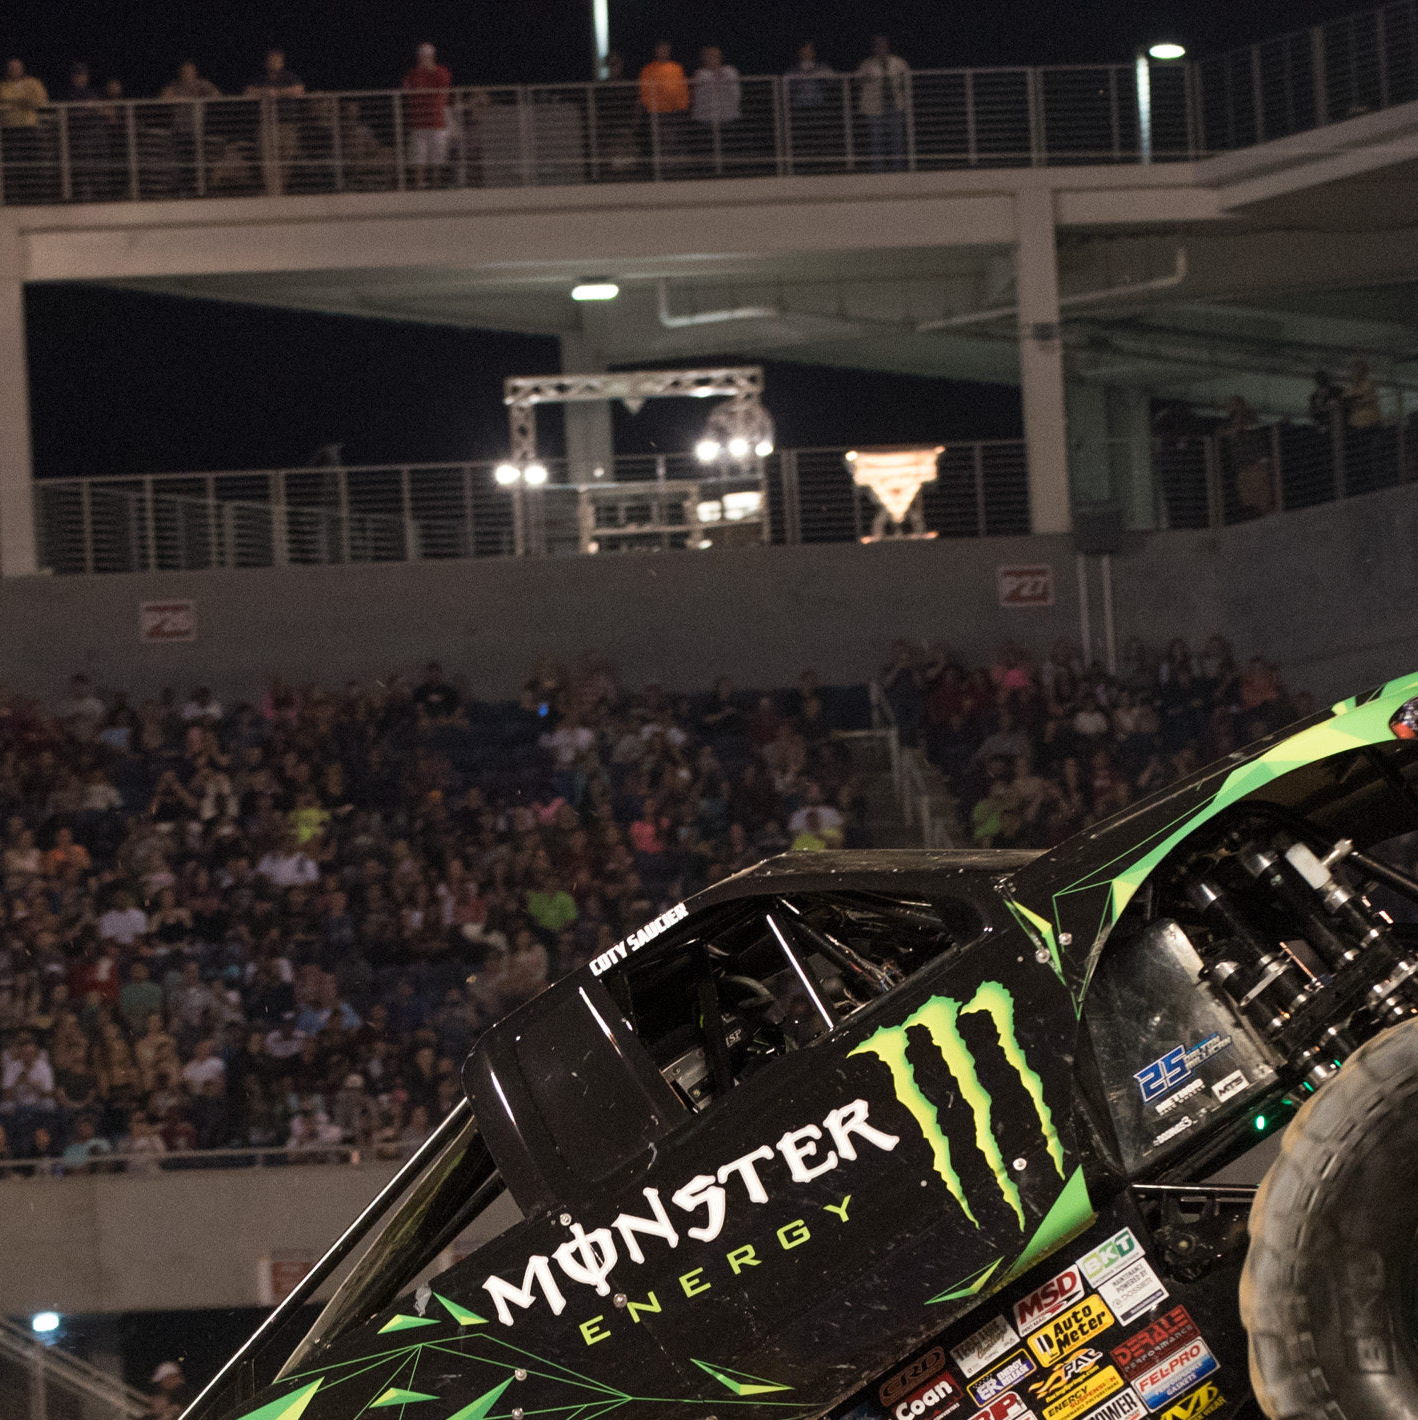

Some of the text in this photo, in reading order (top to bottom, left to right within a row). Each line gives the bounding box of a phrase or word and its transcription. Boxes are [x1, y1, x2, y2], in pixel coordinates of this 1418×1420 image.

[589, 902, 689, 977] COTY SAUCIER
[1133, 1044, 1192, 1103] 25
[482, 1098, 900, 1327] MONSTER
[579, 1194, 852, 1346] ENERGY
[1083, 1231, 1135, 1279] BKT
[1112, 1262, 1145, 1288] MAINTENANCE
[1116, 1275, 1141, 1294] POWERED
[1121, 1277, 1154, 1301] DOSSIER
[1017, 1271, 1077, 1326] MSD
[1053, 1305, 1092, 1338] Auto
[1055, 1311, 1106, 1356] Meter
[1115, 1308, 1189, 1365] DERALE
[996, 1358, 1023, 1379] ENERGY
[1001, 1364, 1030, 1387] RELEASE
[1064, 1349, 1103, 1380] PAC
[1139, 1344, 1201, 1392] FEL-PRO
[976, 1377, 1004, 1401] ER
[1069, 1375, 1117, 1410] SUSPENSIN
[1166, 1372, 1198, 1396] GASKETS
[1048, 1385, 1089, 1418] ENERGY
[1203, 1396, 1228, 1418] WEAR
